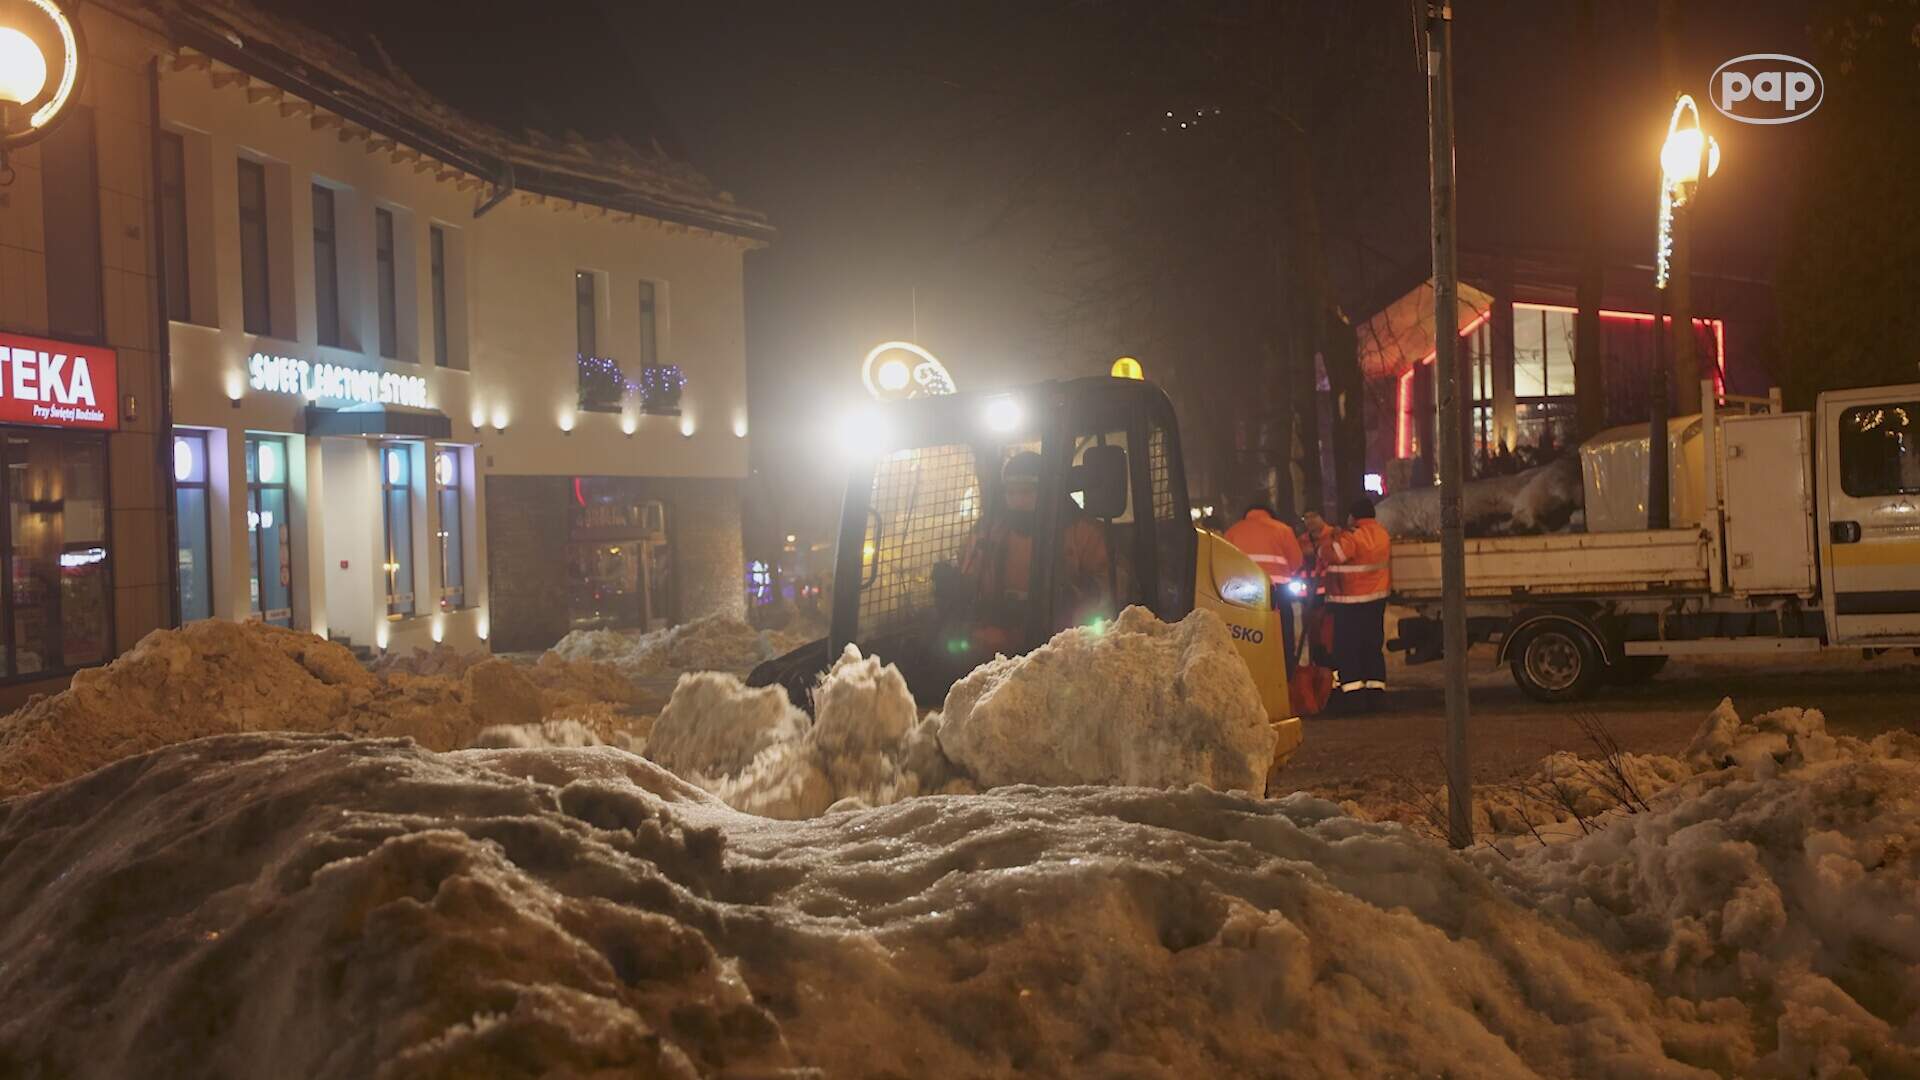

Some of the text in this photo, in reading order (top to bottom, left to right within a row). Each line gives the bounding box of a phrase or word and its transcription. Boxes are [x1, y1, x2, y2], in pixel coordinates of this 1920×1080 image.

[249, 352, 309, 394] SWEET
[380, 372, 426, 408] STORE
[33, 404, 50, 419] Przy
